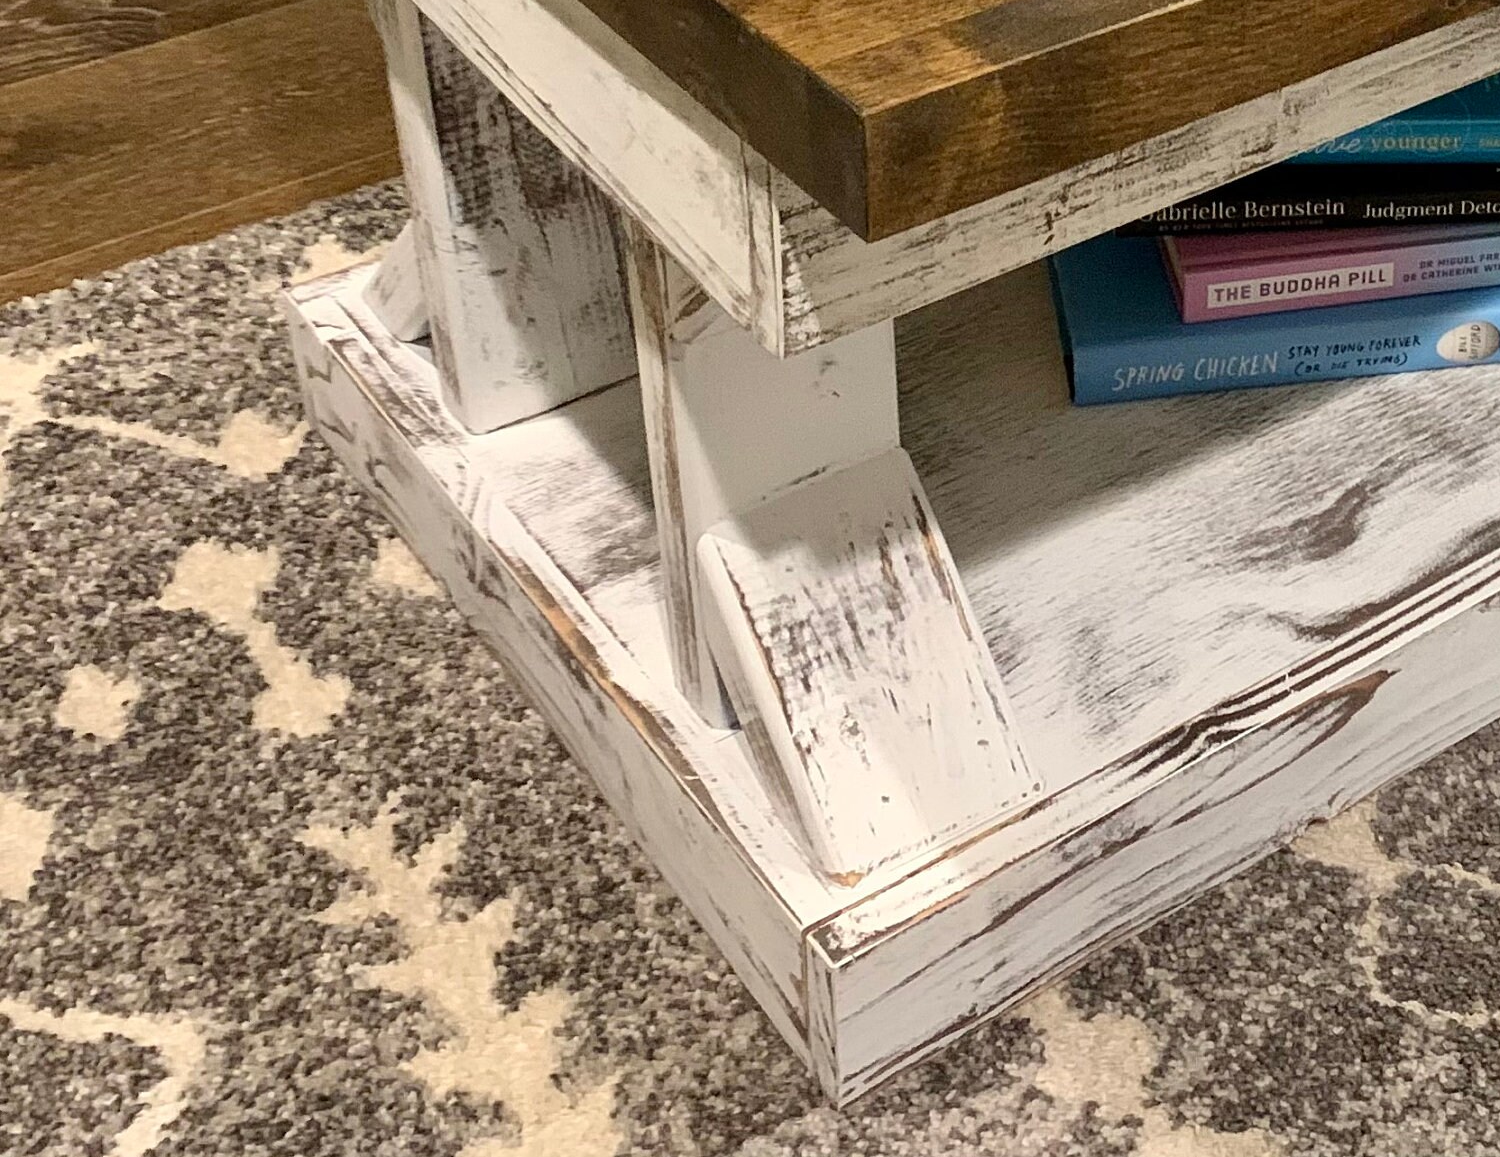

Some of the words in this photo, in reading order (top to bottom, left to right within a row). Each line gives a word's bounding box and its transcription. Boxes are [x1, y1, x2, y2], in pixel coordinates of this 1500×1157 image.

[1370, 134, 1462, 153] younger
[1244, 199, 1345, 218] Bernstein
[1363, 201, 1453, 220] Judgment
[1419, 259, 1434, 269] DR
[1438, 255, 1475, 267] MIGUEL
[1403, 273, 1417, 282] DR
[1421, 266, 1479, 280] CATHERINE
[1214, 285, 1252, 302] THE
[1259, 274, 1341, 297] BUDDHA
[1348, 269, 1387, 286] PILL
[1288, 345, 1319, 359] STAY
[1326, 343, 1365, 357] YOUNG
[1369, 335, 1422, 351] FOREVER
[1112, 362, 1185, 391] SPRING
[1194, 351, 1279, 381] CHICKEN
